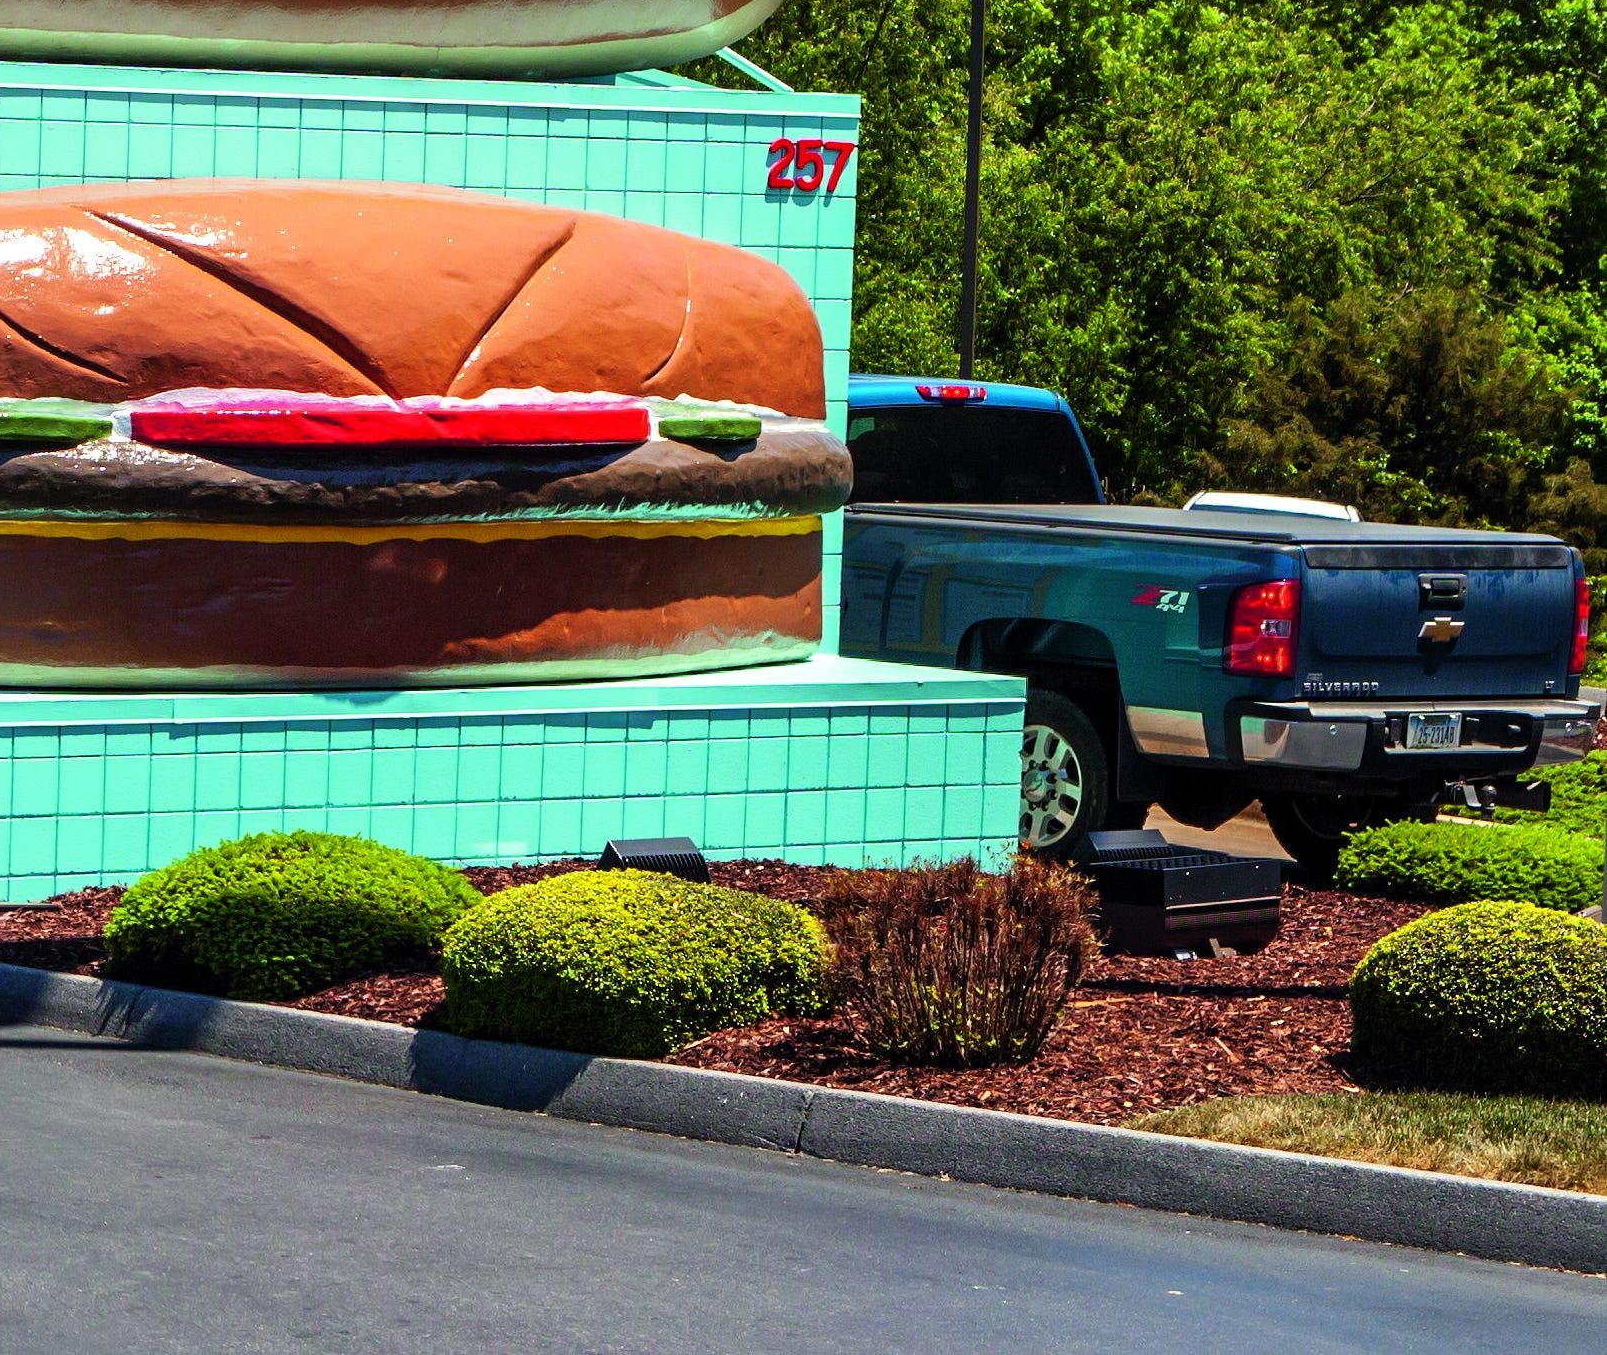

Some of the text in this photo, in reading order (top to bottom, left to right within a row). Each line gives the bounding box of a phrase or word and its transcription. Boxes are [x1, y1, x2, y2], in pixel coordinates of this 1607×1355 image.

[767, 138, 855, 193] 257
[1130, 585, 1190, 605] Z71
[1303, 681, 1380, 692] SILVERADO
